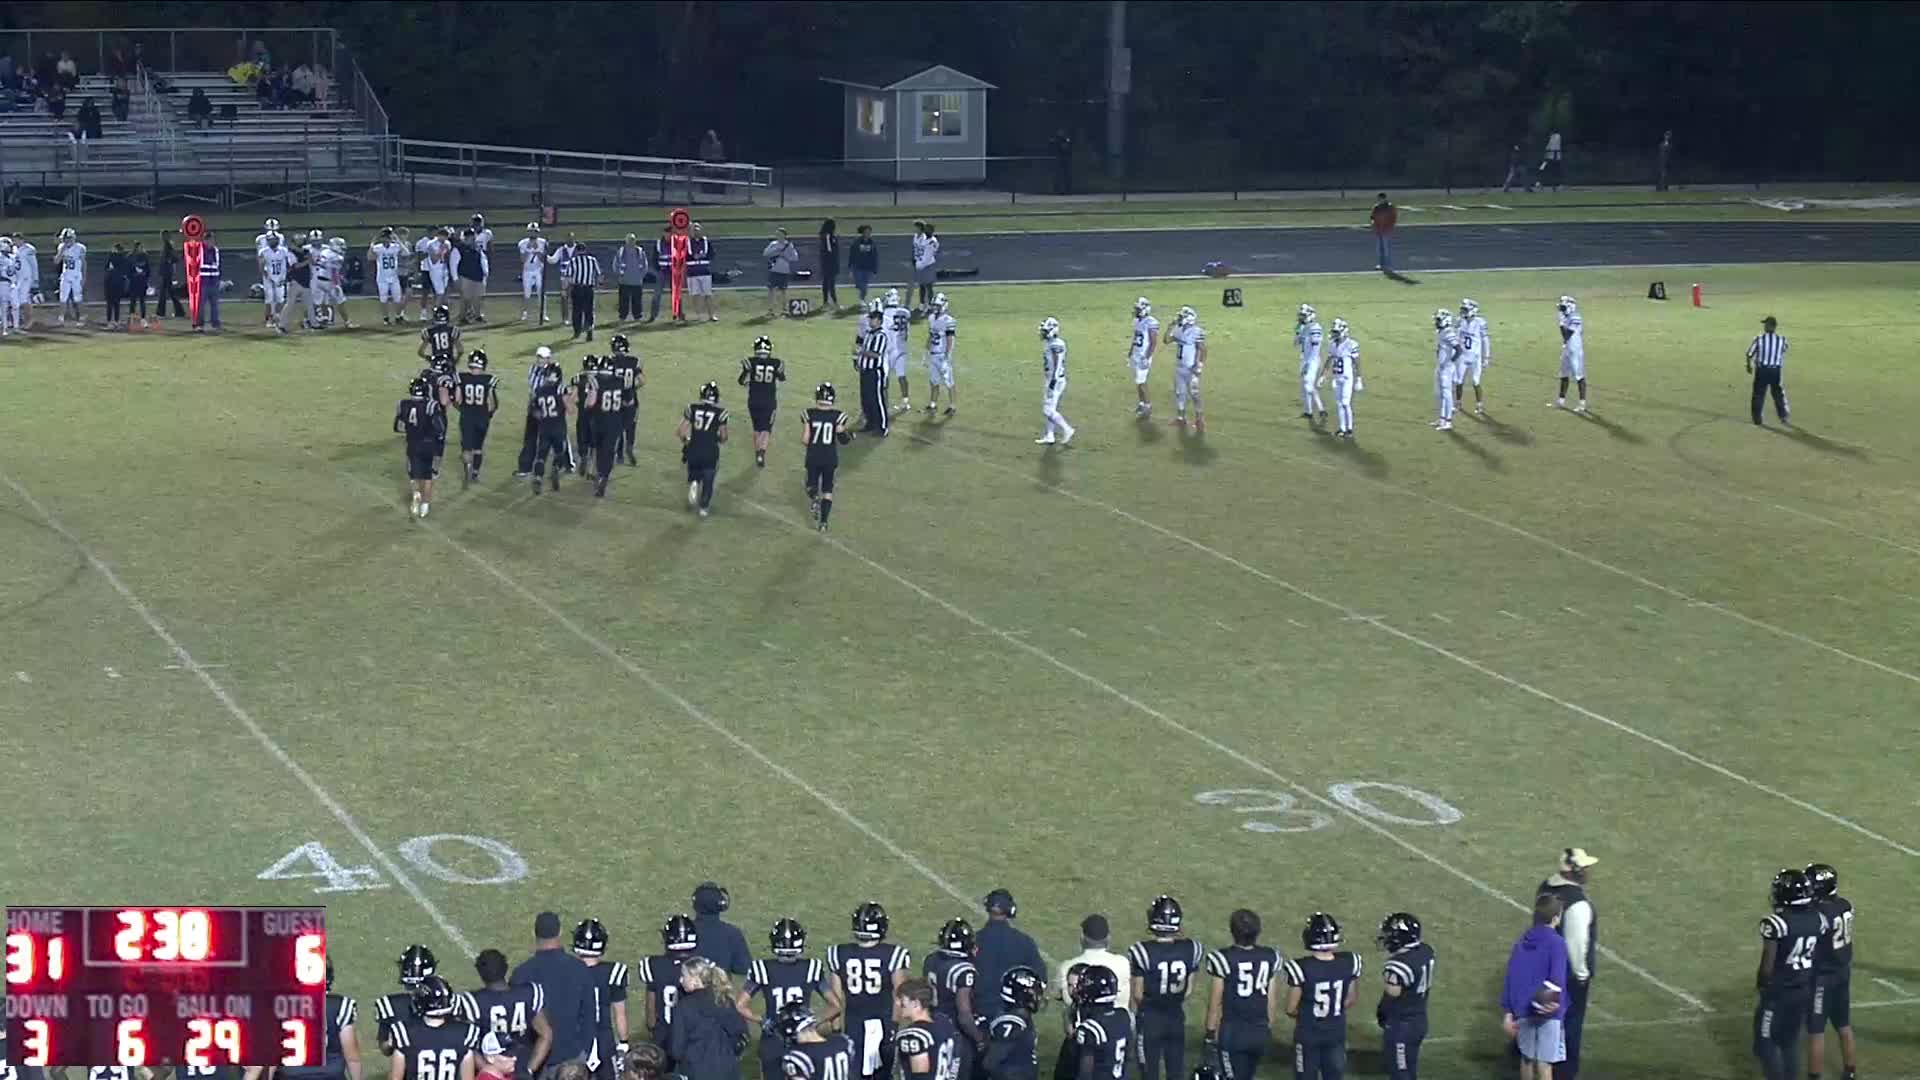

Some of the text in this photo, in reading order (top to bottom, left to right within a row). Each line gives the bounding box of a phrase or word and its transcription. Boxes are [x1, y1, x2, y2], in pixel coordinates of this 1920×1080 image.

[433, 332, 449, 350] 18
[755, 365, 775, 383] 56
[464, 383, 485, 405] 99
[602, 390, 622, 411] 65
[408, 407, 418, 427] 4
[694, 411, 715, 431] 57
[812, 421, 834, 445] 70
[256, 833, 529, 894] 40
[845, 958, 882, 995] 85
[966, 972, 974, 987] 6
[1157, 960, 1187, 995] 13
[1237, 961, 1270, 998] 54
[1313, 979, 1344, 1018] 51
[490, 1001, 528, 1036] 64
[1003, 1024, 1012, 1038] 7
[417, 1049, 457, 1080] 66
